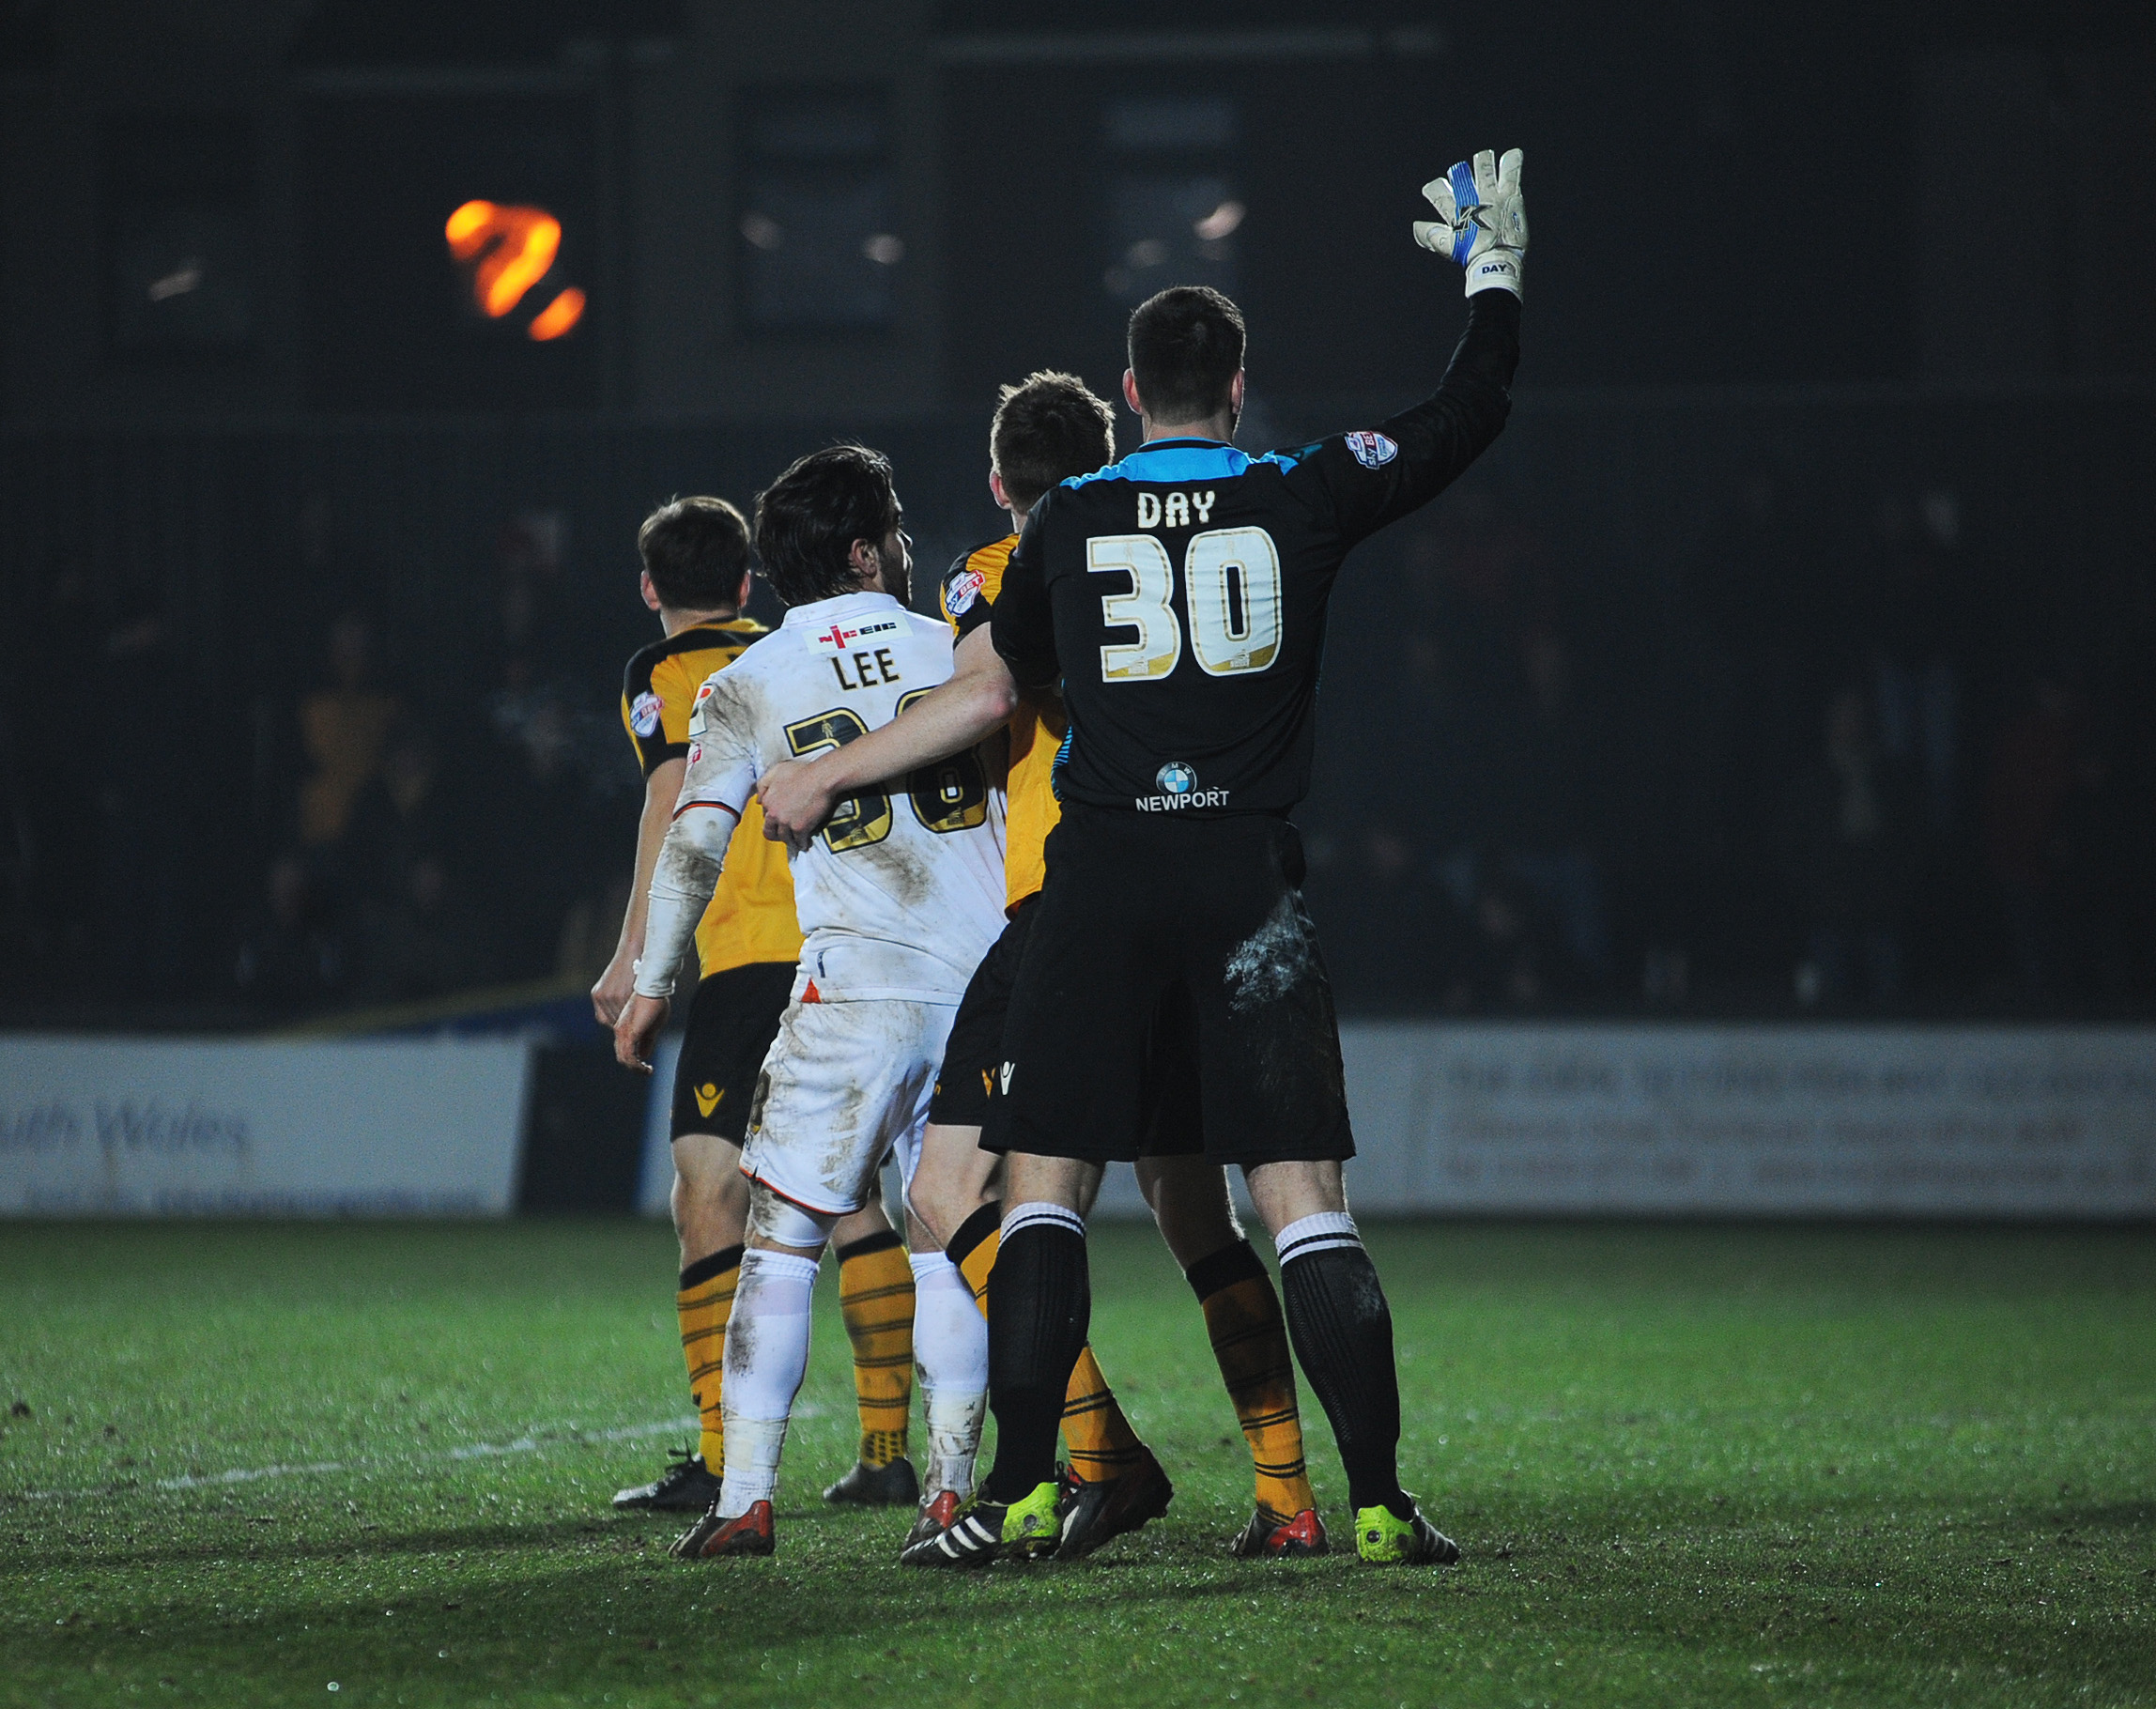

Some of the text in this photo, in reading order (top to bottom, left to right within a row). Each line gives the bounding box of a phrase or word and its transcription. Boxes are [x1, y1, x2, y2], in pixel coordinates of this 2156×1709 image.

[1482, 264, 1507, 274] DAY
[1137, 490, 1216, 529] DAY
[1086, 526, 1283, 683] 30
[832, 648, 900, 690] LEE
[1135, 790, 1230, 812] NEWPORT
